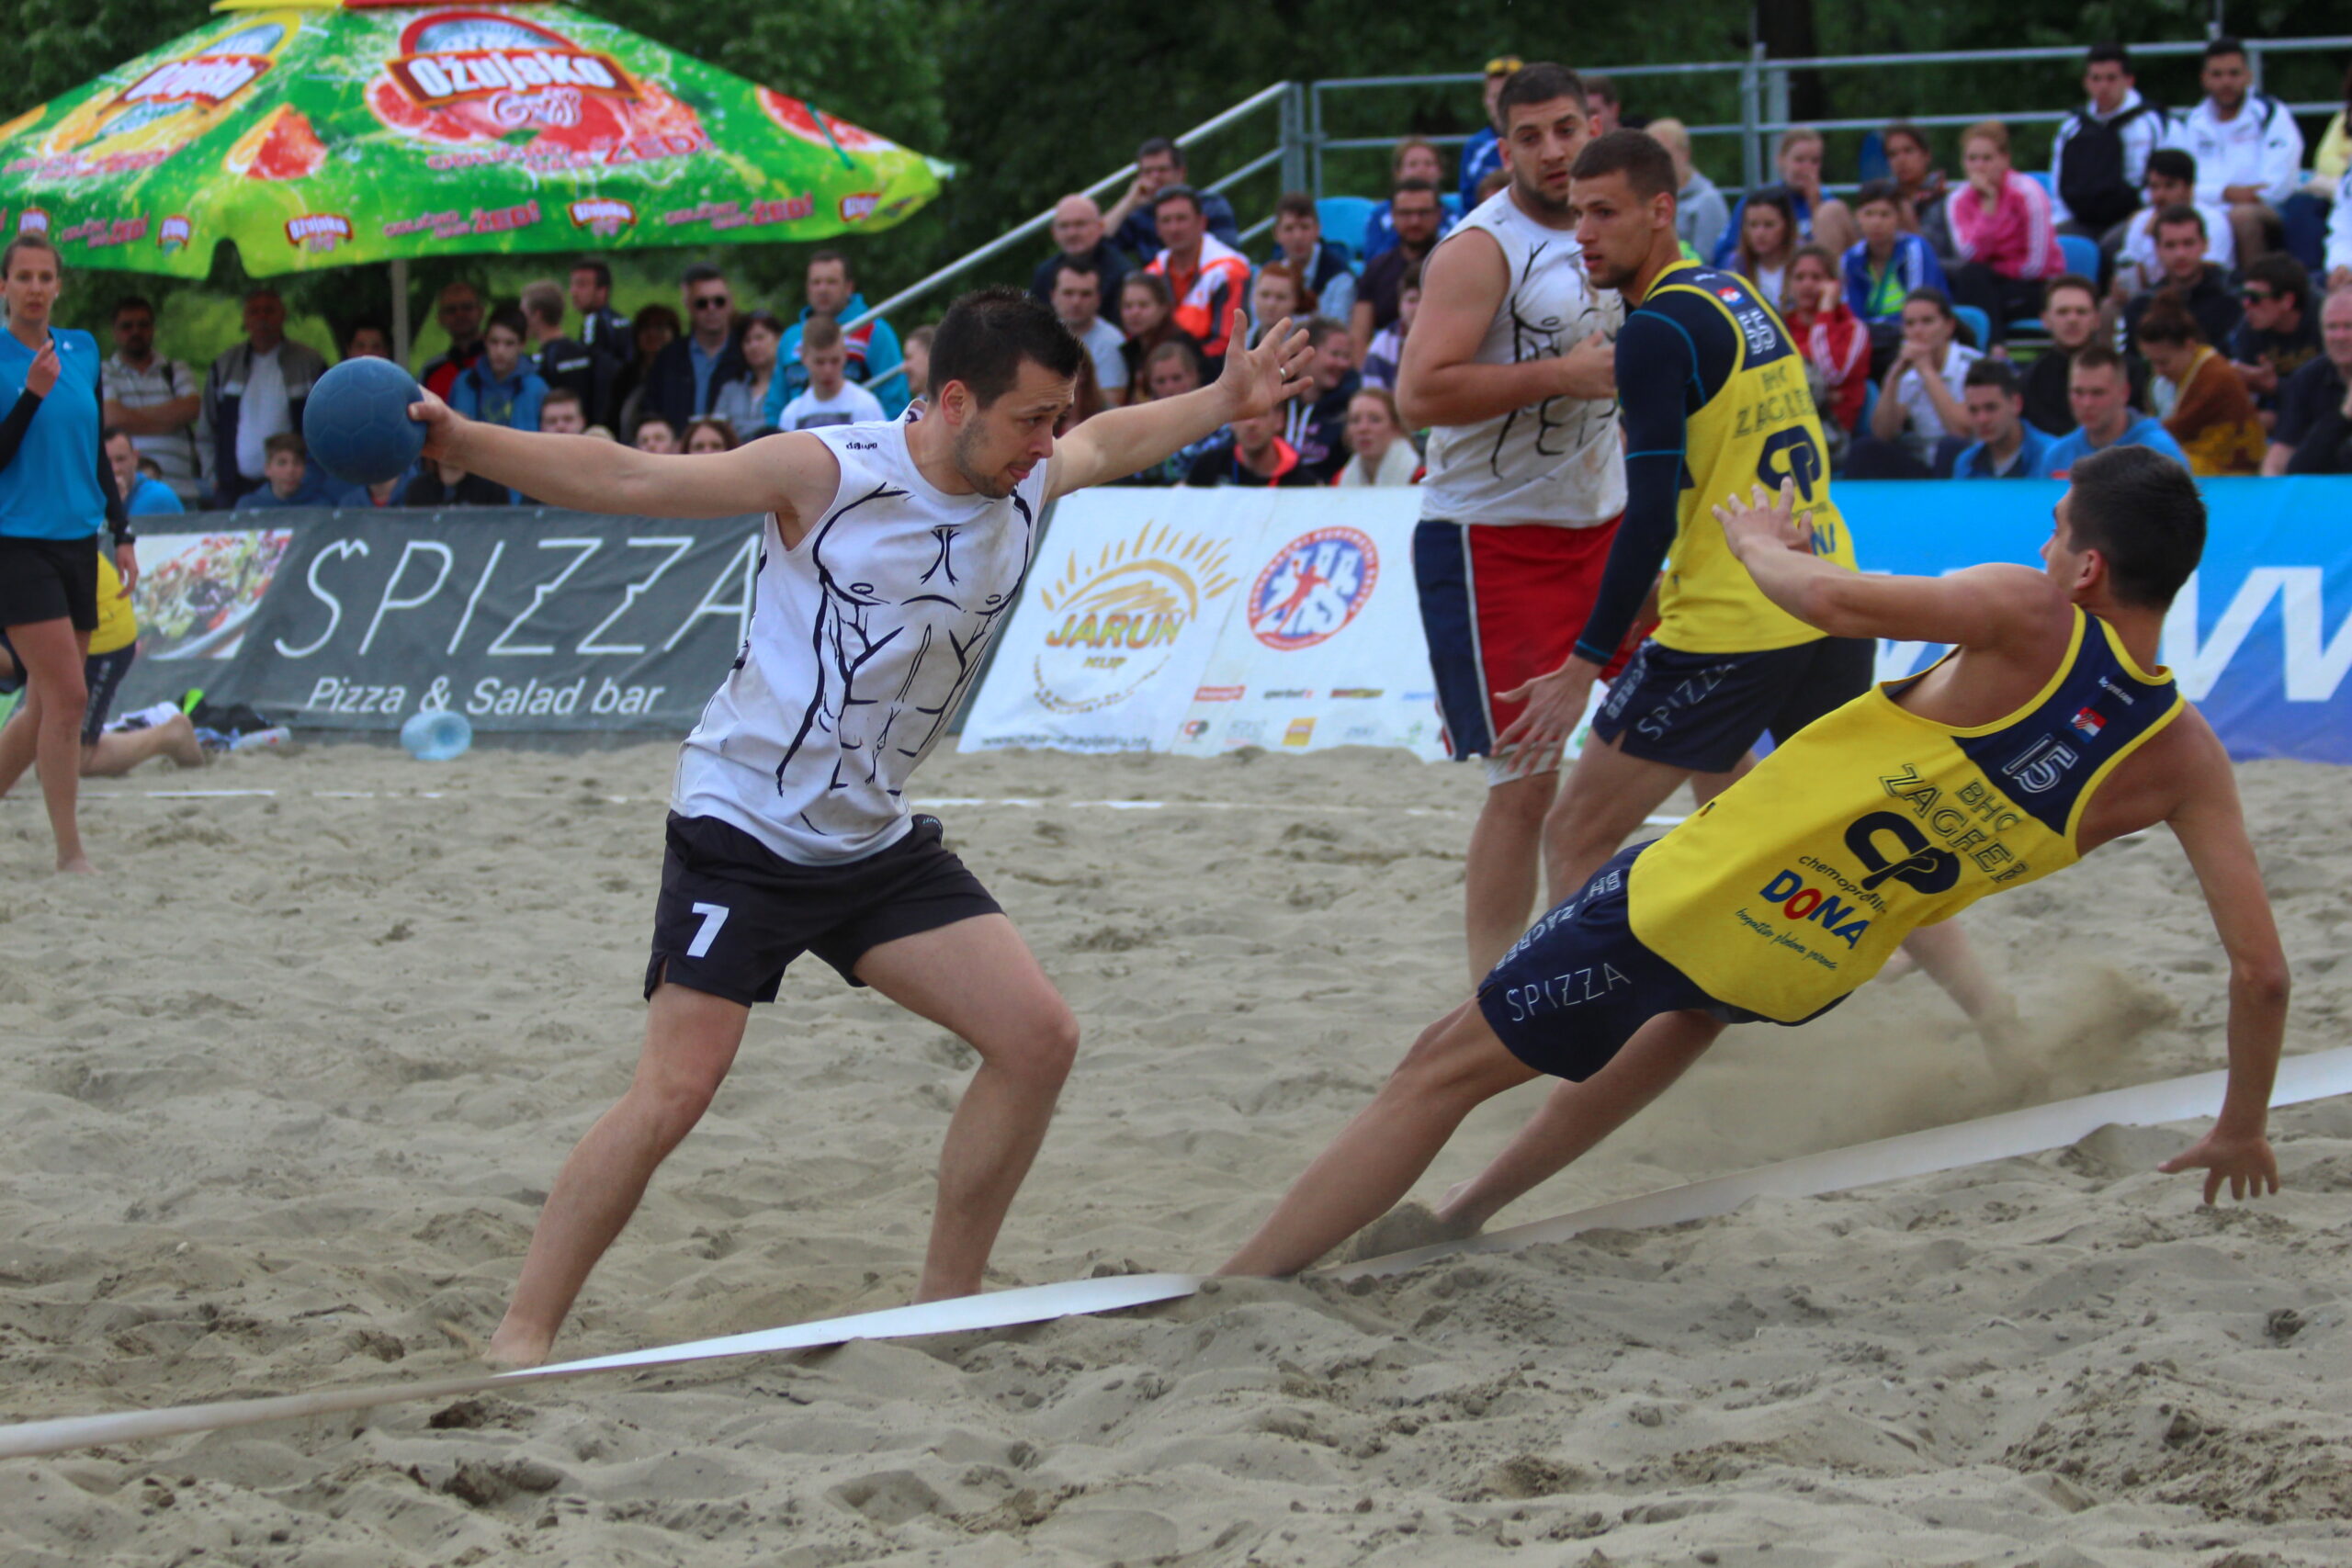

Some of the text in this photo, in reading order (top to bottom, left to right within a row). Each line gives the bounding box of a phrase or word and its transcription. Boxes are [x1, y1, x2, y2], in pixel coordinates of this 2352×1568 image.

[275, 533, 761, 659] SPIZZA
[1046, 612, 1188, 649] JARUN
[306, 677, 665, 715] Pizza & Salad bar
[2002, 733, 2078, 793] 15
[1955, 779, 2022, 831] BHC
[1582, 870, 1621, 903] BH
[1758, 868, 1871, 950] DONA
[685, 901, 729, 957] 7
[1506, 963, 1632, 1021] SPIZZA
